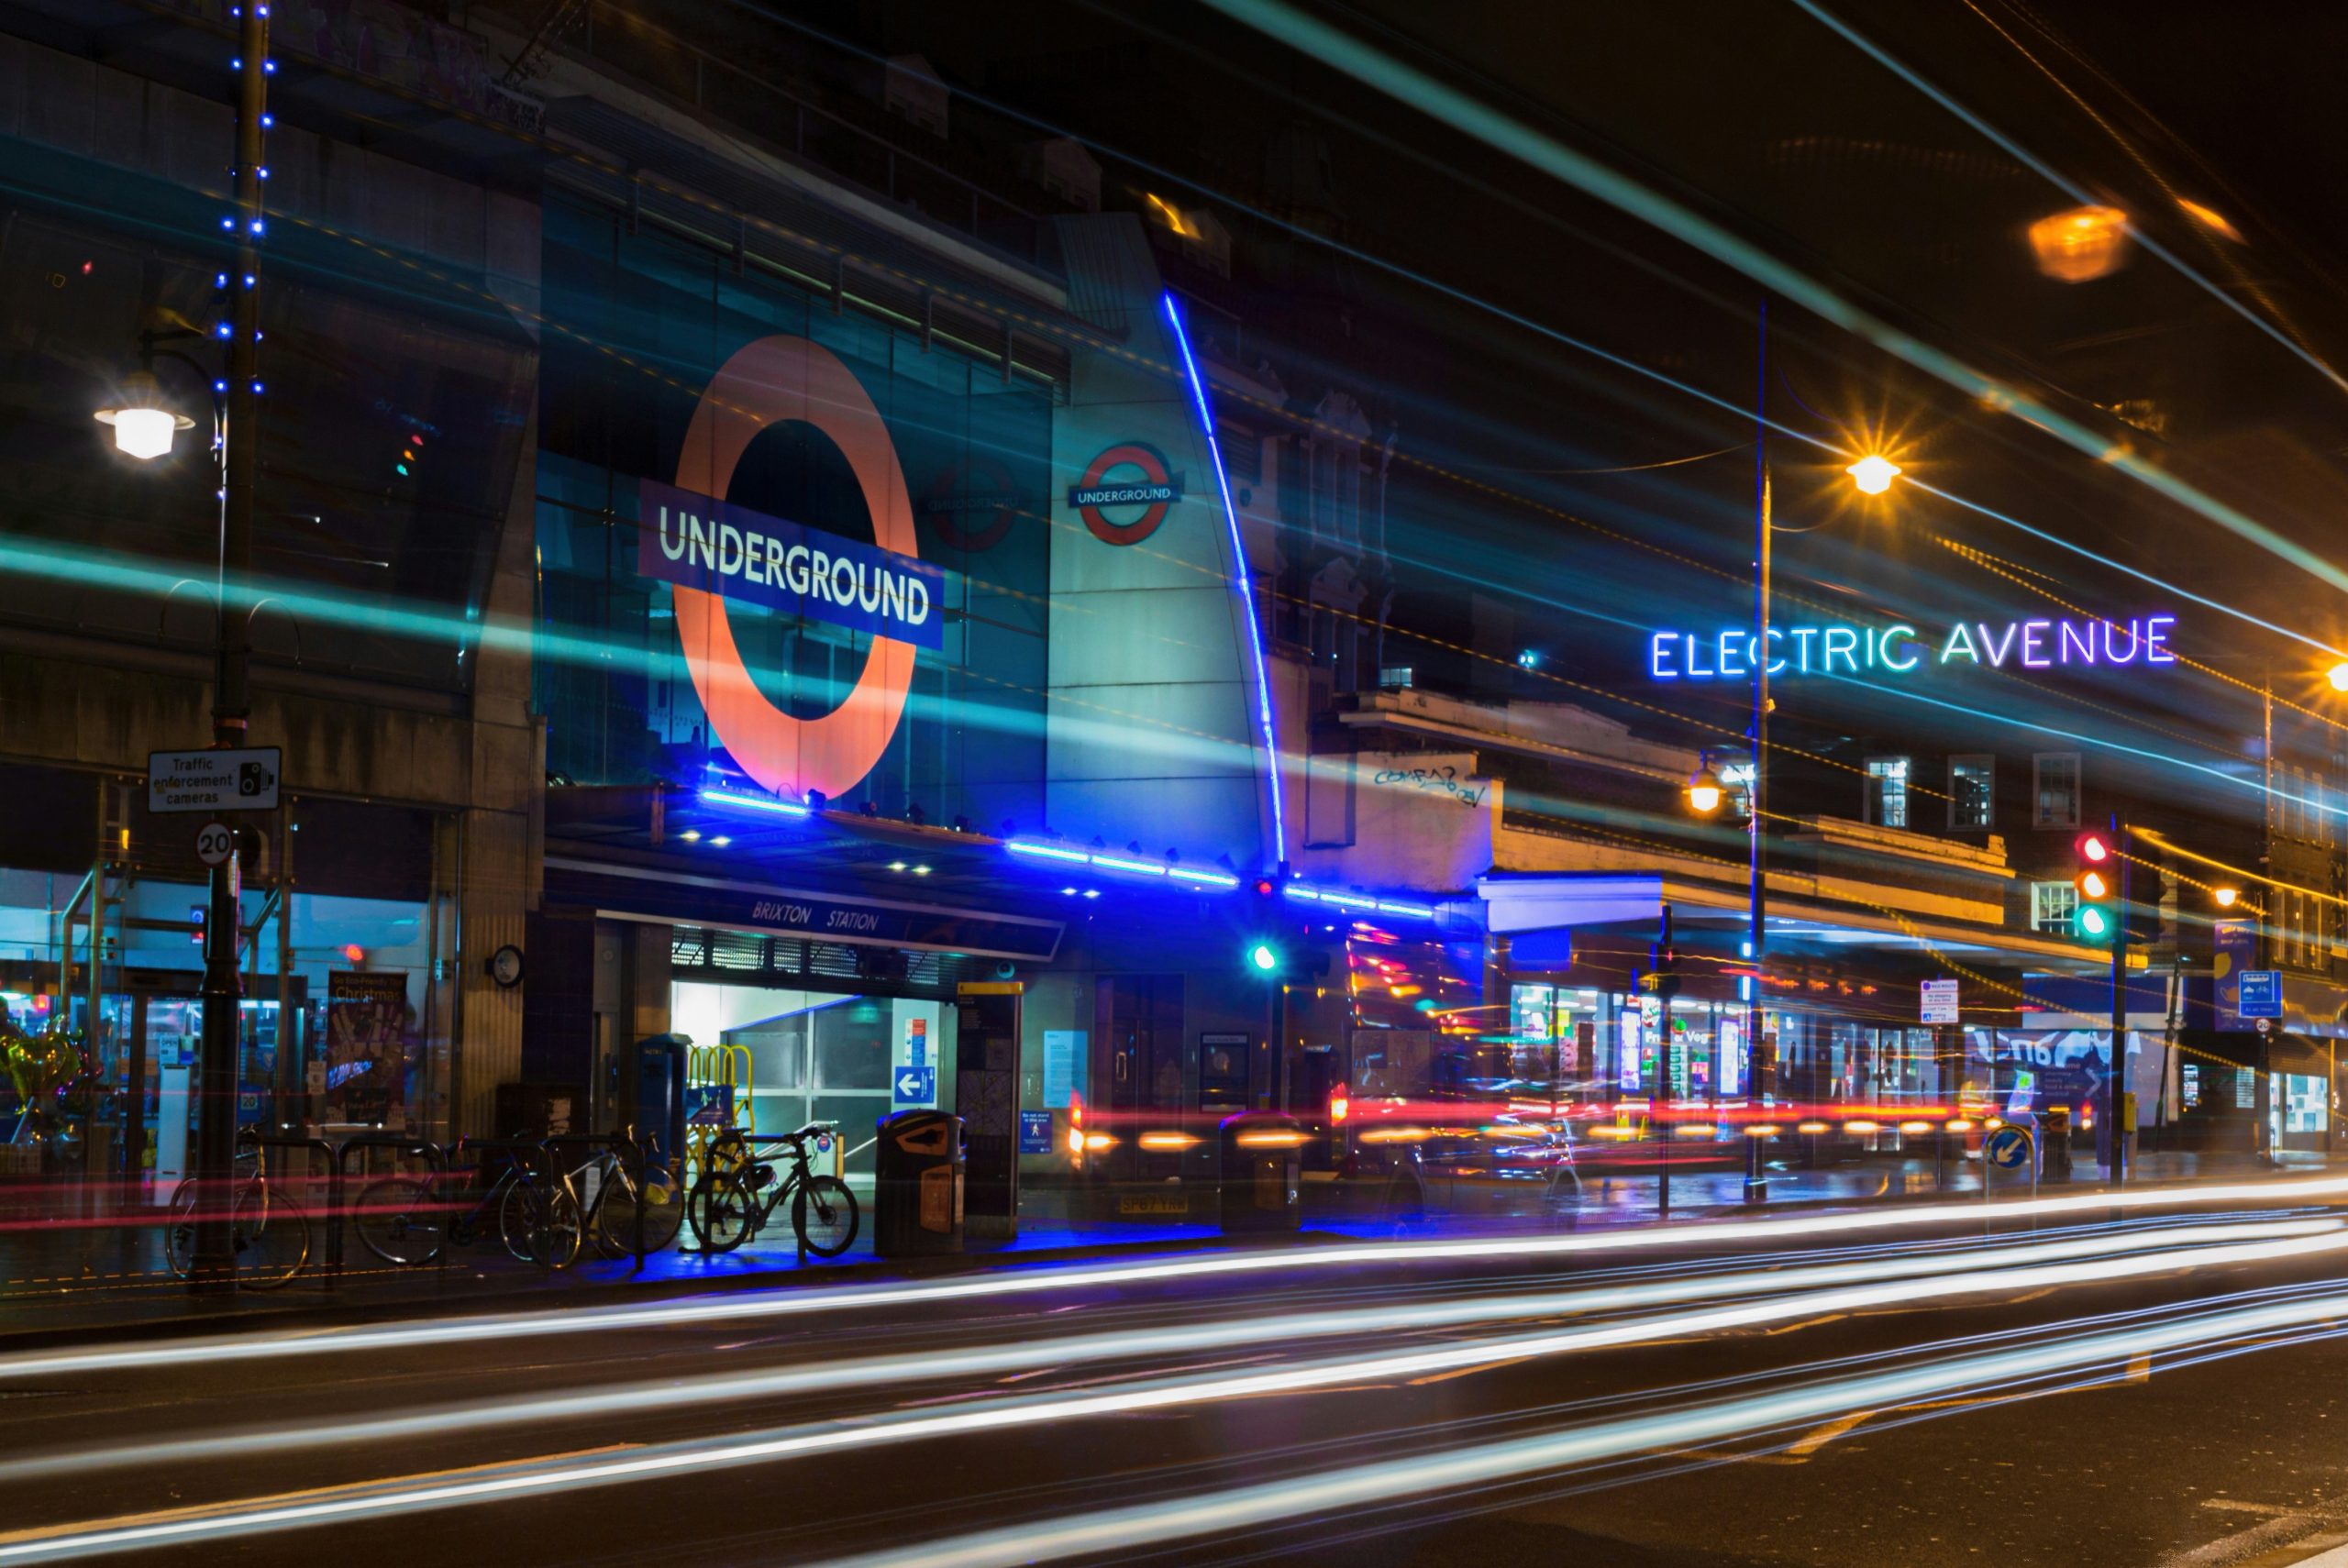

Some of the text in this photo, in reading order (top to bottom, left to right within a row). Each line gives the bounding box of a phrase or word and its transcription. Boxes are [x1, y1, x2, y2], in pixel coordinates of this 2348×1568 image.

[1078, 488, 1171, 503] UNDERGROUND
[659, 506, 929, 625] UNDERGROUND
[1652, 617, 2176, 677] ELECTRIC AVENUE
[173, 758, 213, 770] Traffic
[154, 774, 233, 788] enforcement
[167, 792, 218, 804] cameras
[201, 834, 229, 854] 20
[752, 901, 880, 931] BRIXTON STATION
[336, 986, 402, 1002] Christmas
[1686, 1031, 1709, 1044] Veg
